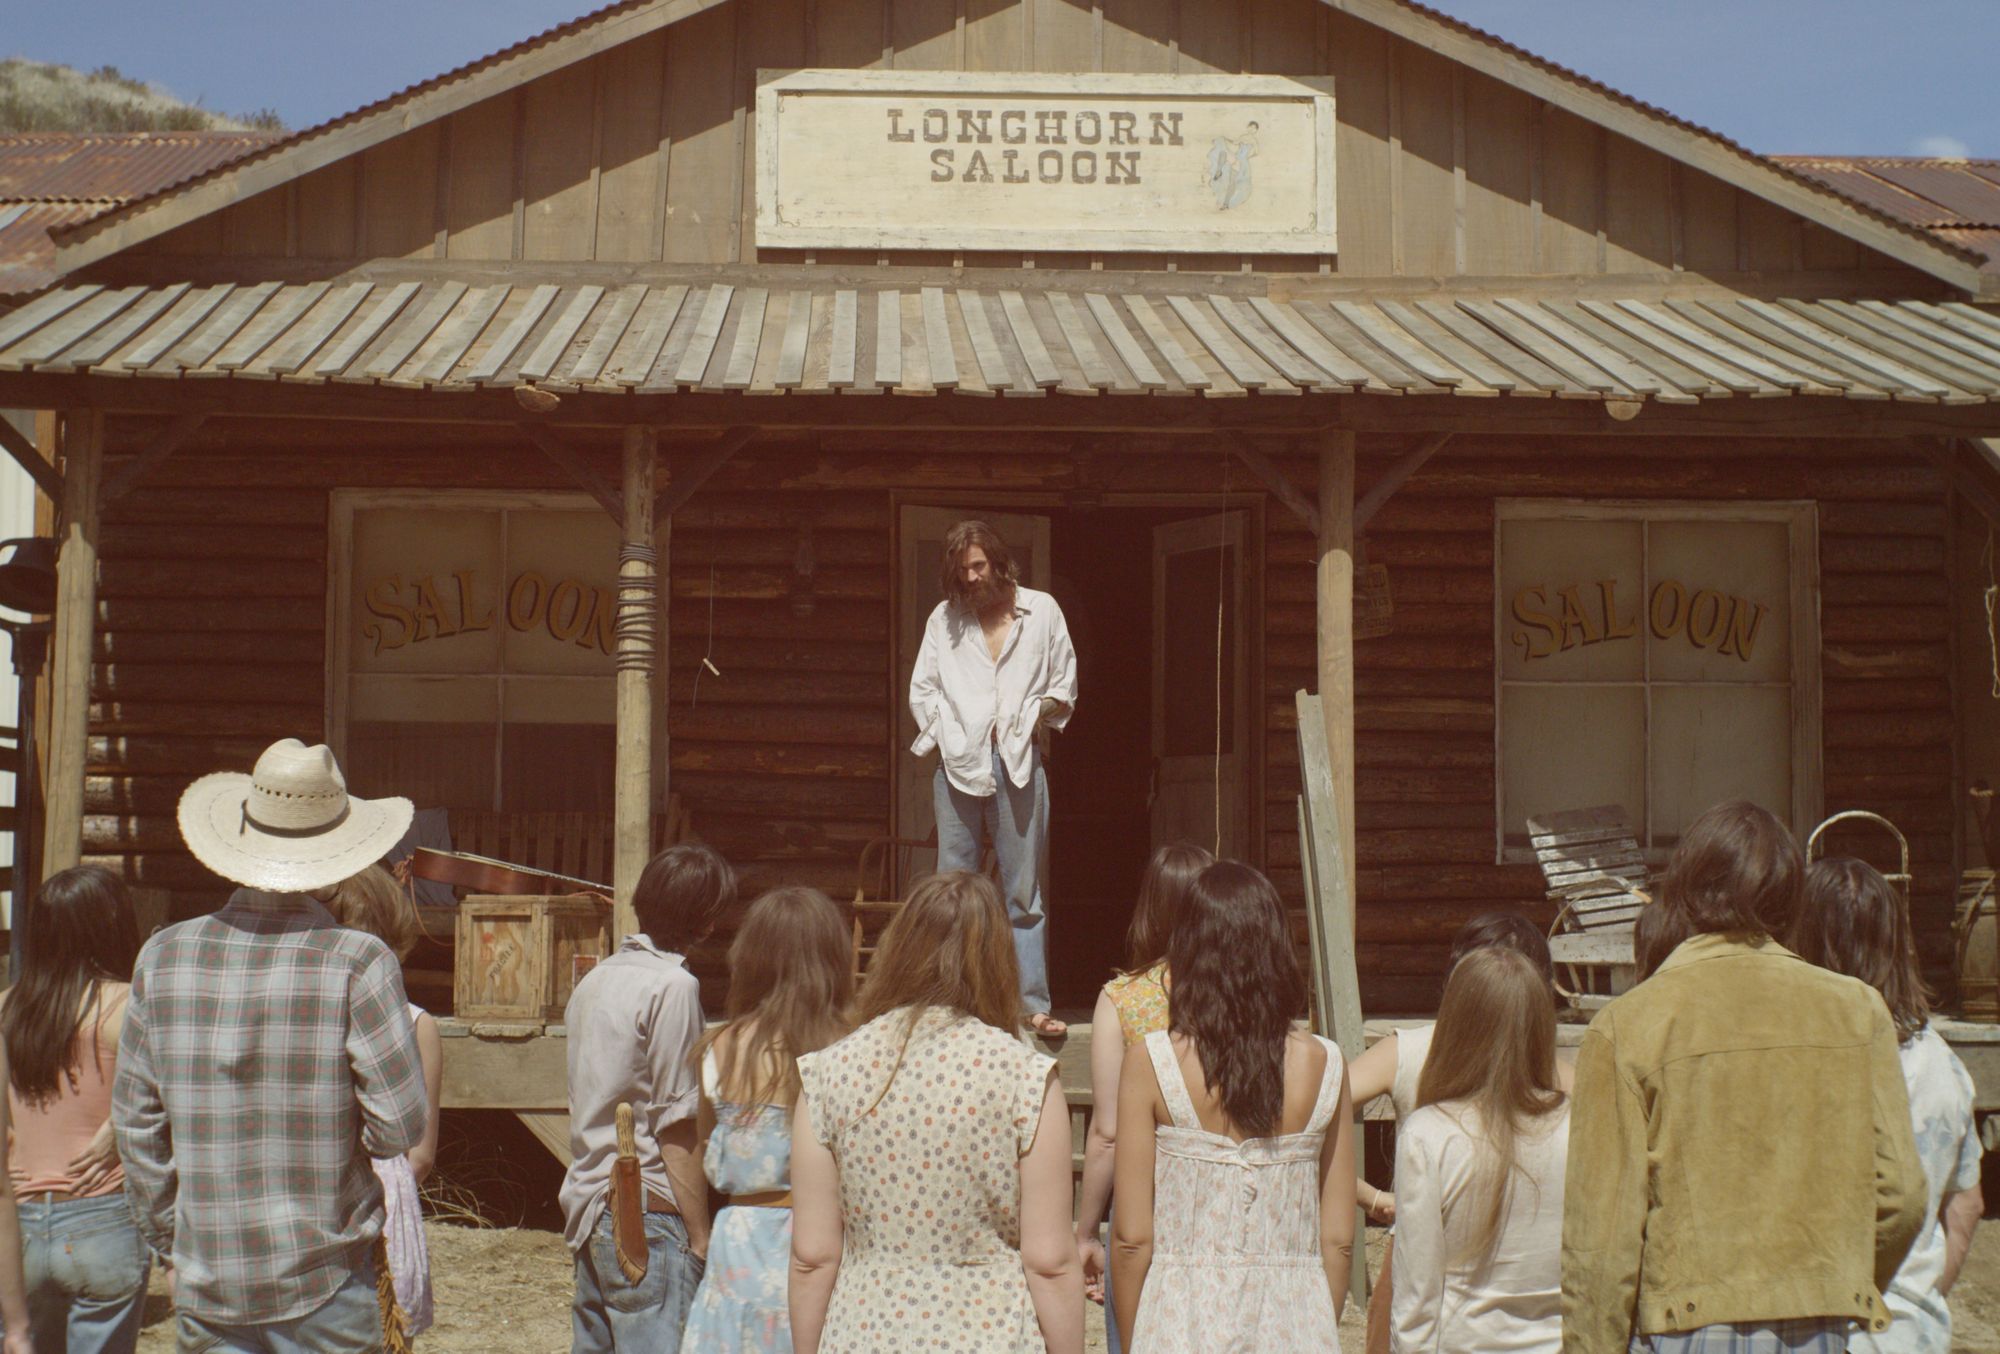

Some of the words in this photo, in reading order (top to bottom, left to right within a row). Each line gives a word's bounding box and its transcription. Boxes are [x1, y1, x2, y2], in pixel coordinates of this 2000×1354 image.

[887, 109, 1185, 145] LONGHORN
[930, 149, 1141, 184] SALOON
[363, 570, 619, 657] SALOON
[1511, 578, 1769, 662] SALOON
